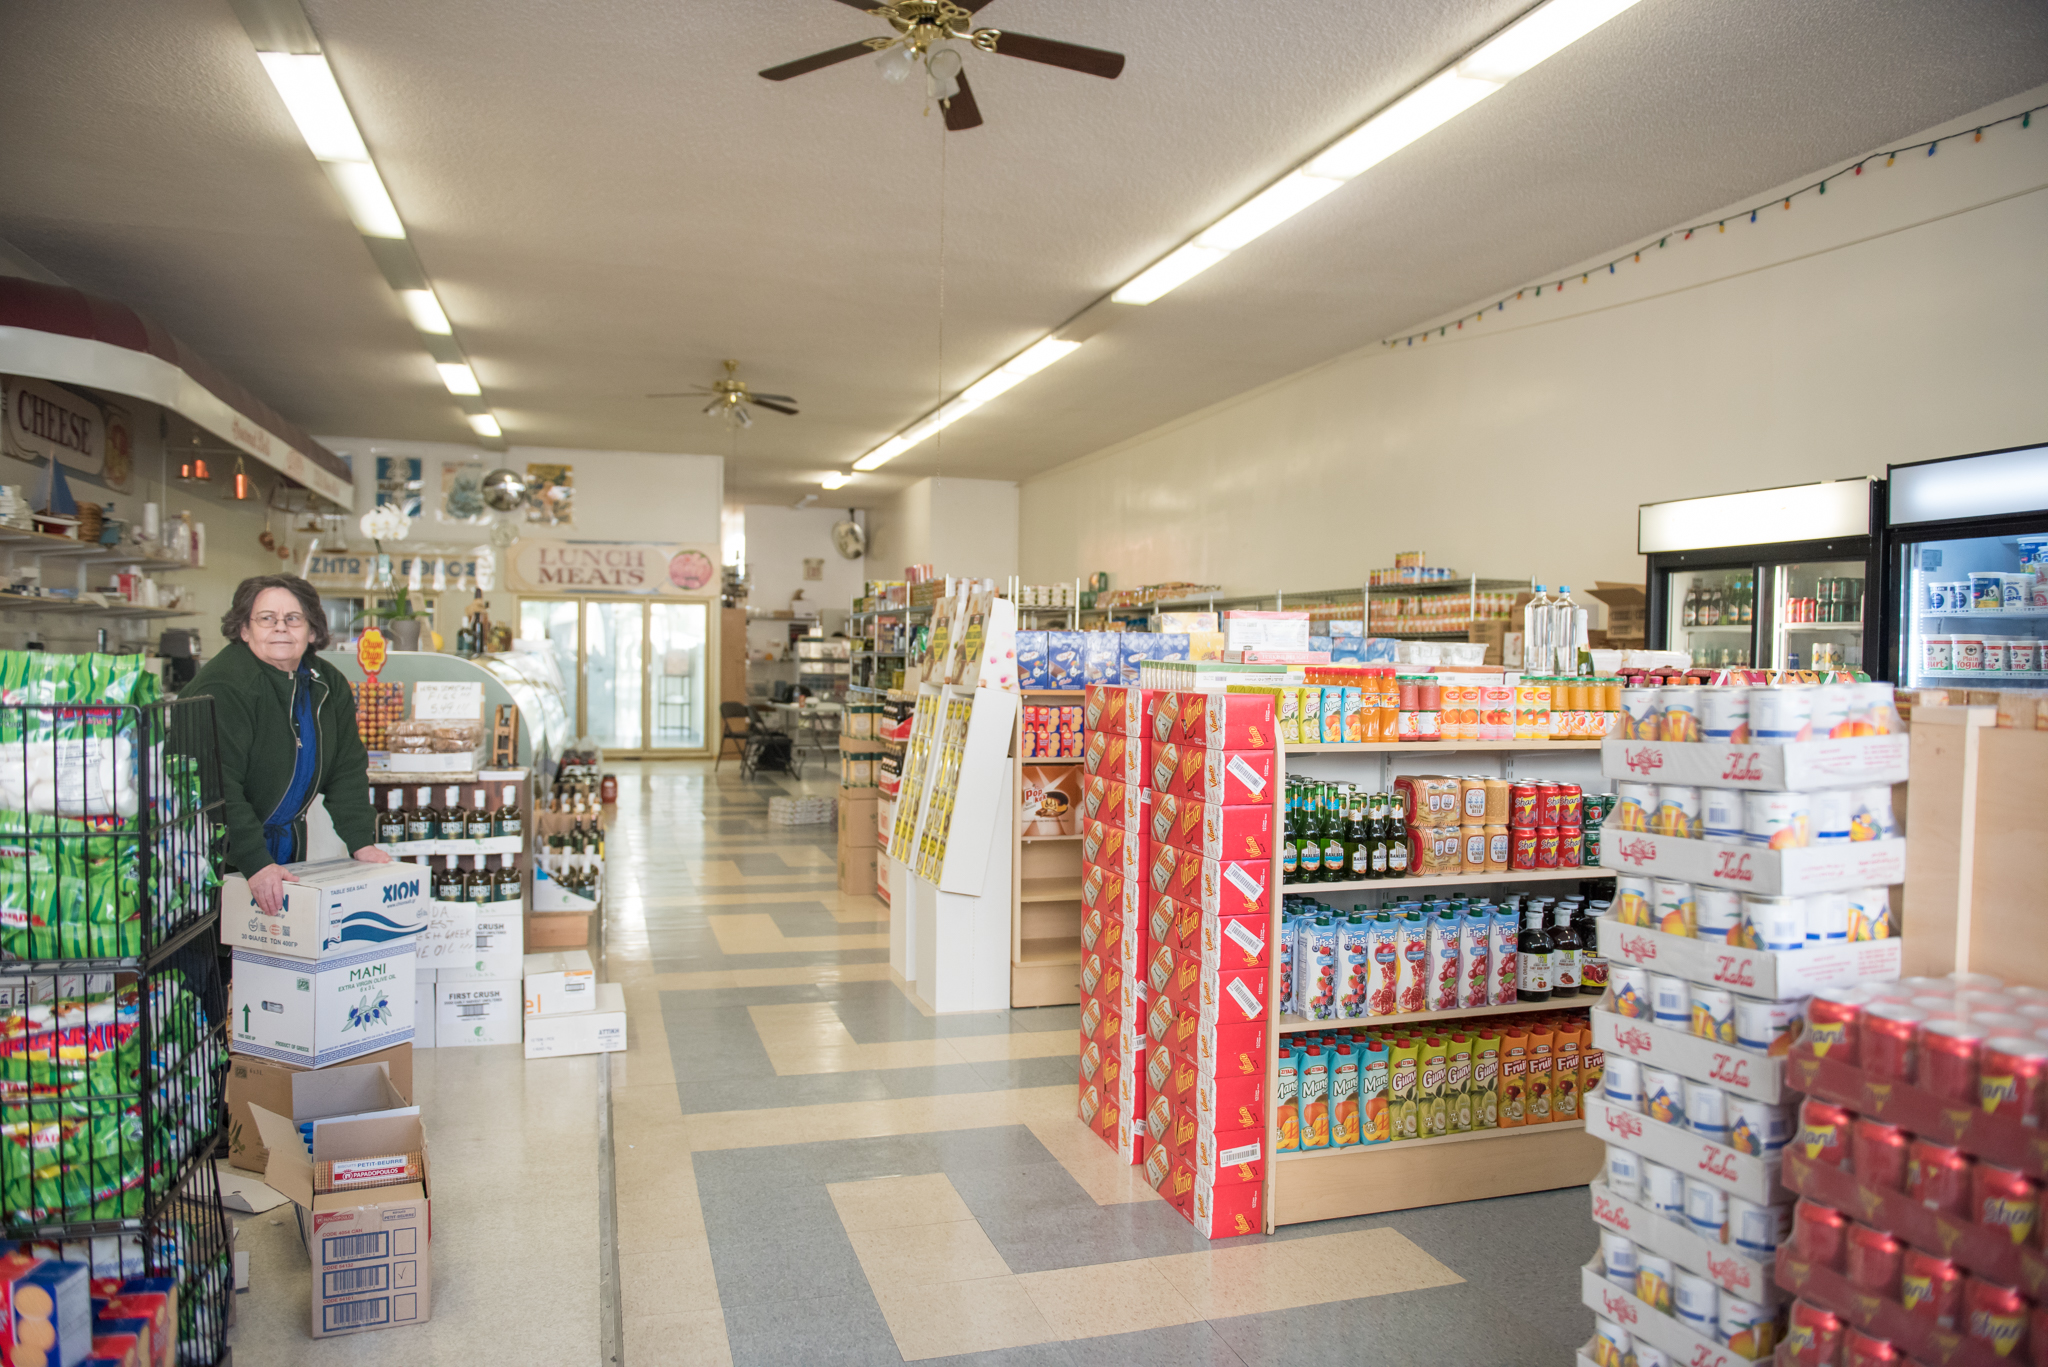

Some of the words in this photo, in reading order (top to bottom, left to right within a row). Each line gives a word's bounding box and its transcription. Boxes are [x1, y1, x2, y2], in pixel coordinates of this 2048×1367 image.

[18, 390, 92, 457] CHEESE
[539, 548, 645, 567] LUNCH
[538, 567, 645, 585] MEATS
[362, 639, 383, 650] Chupa
[361, 650, 382, 662] Chups
[1282, 701, 1298, 713] Guav
[1025, 789, 1043, 800] Pop
[330, 887, 345, 896] TABLE
[356, 883, 368, 891] SALT
[382, 879, 420, 904] XION
[350, 963, 386, 982] MANI
[338, 984, 355, 993] EXTRA
[356, 979, 373, 988] VIRGIN
[373, 976, 388, 984] OLIVE
[1583, 1053, 1605, 1069] Frui
[357, 1158, 403, 1168] PETIT-BEURRE
[353, 1168, 398, 1178] PAPADOPOULOS
